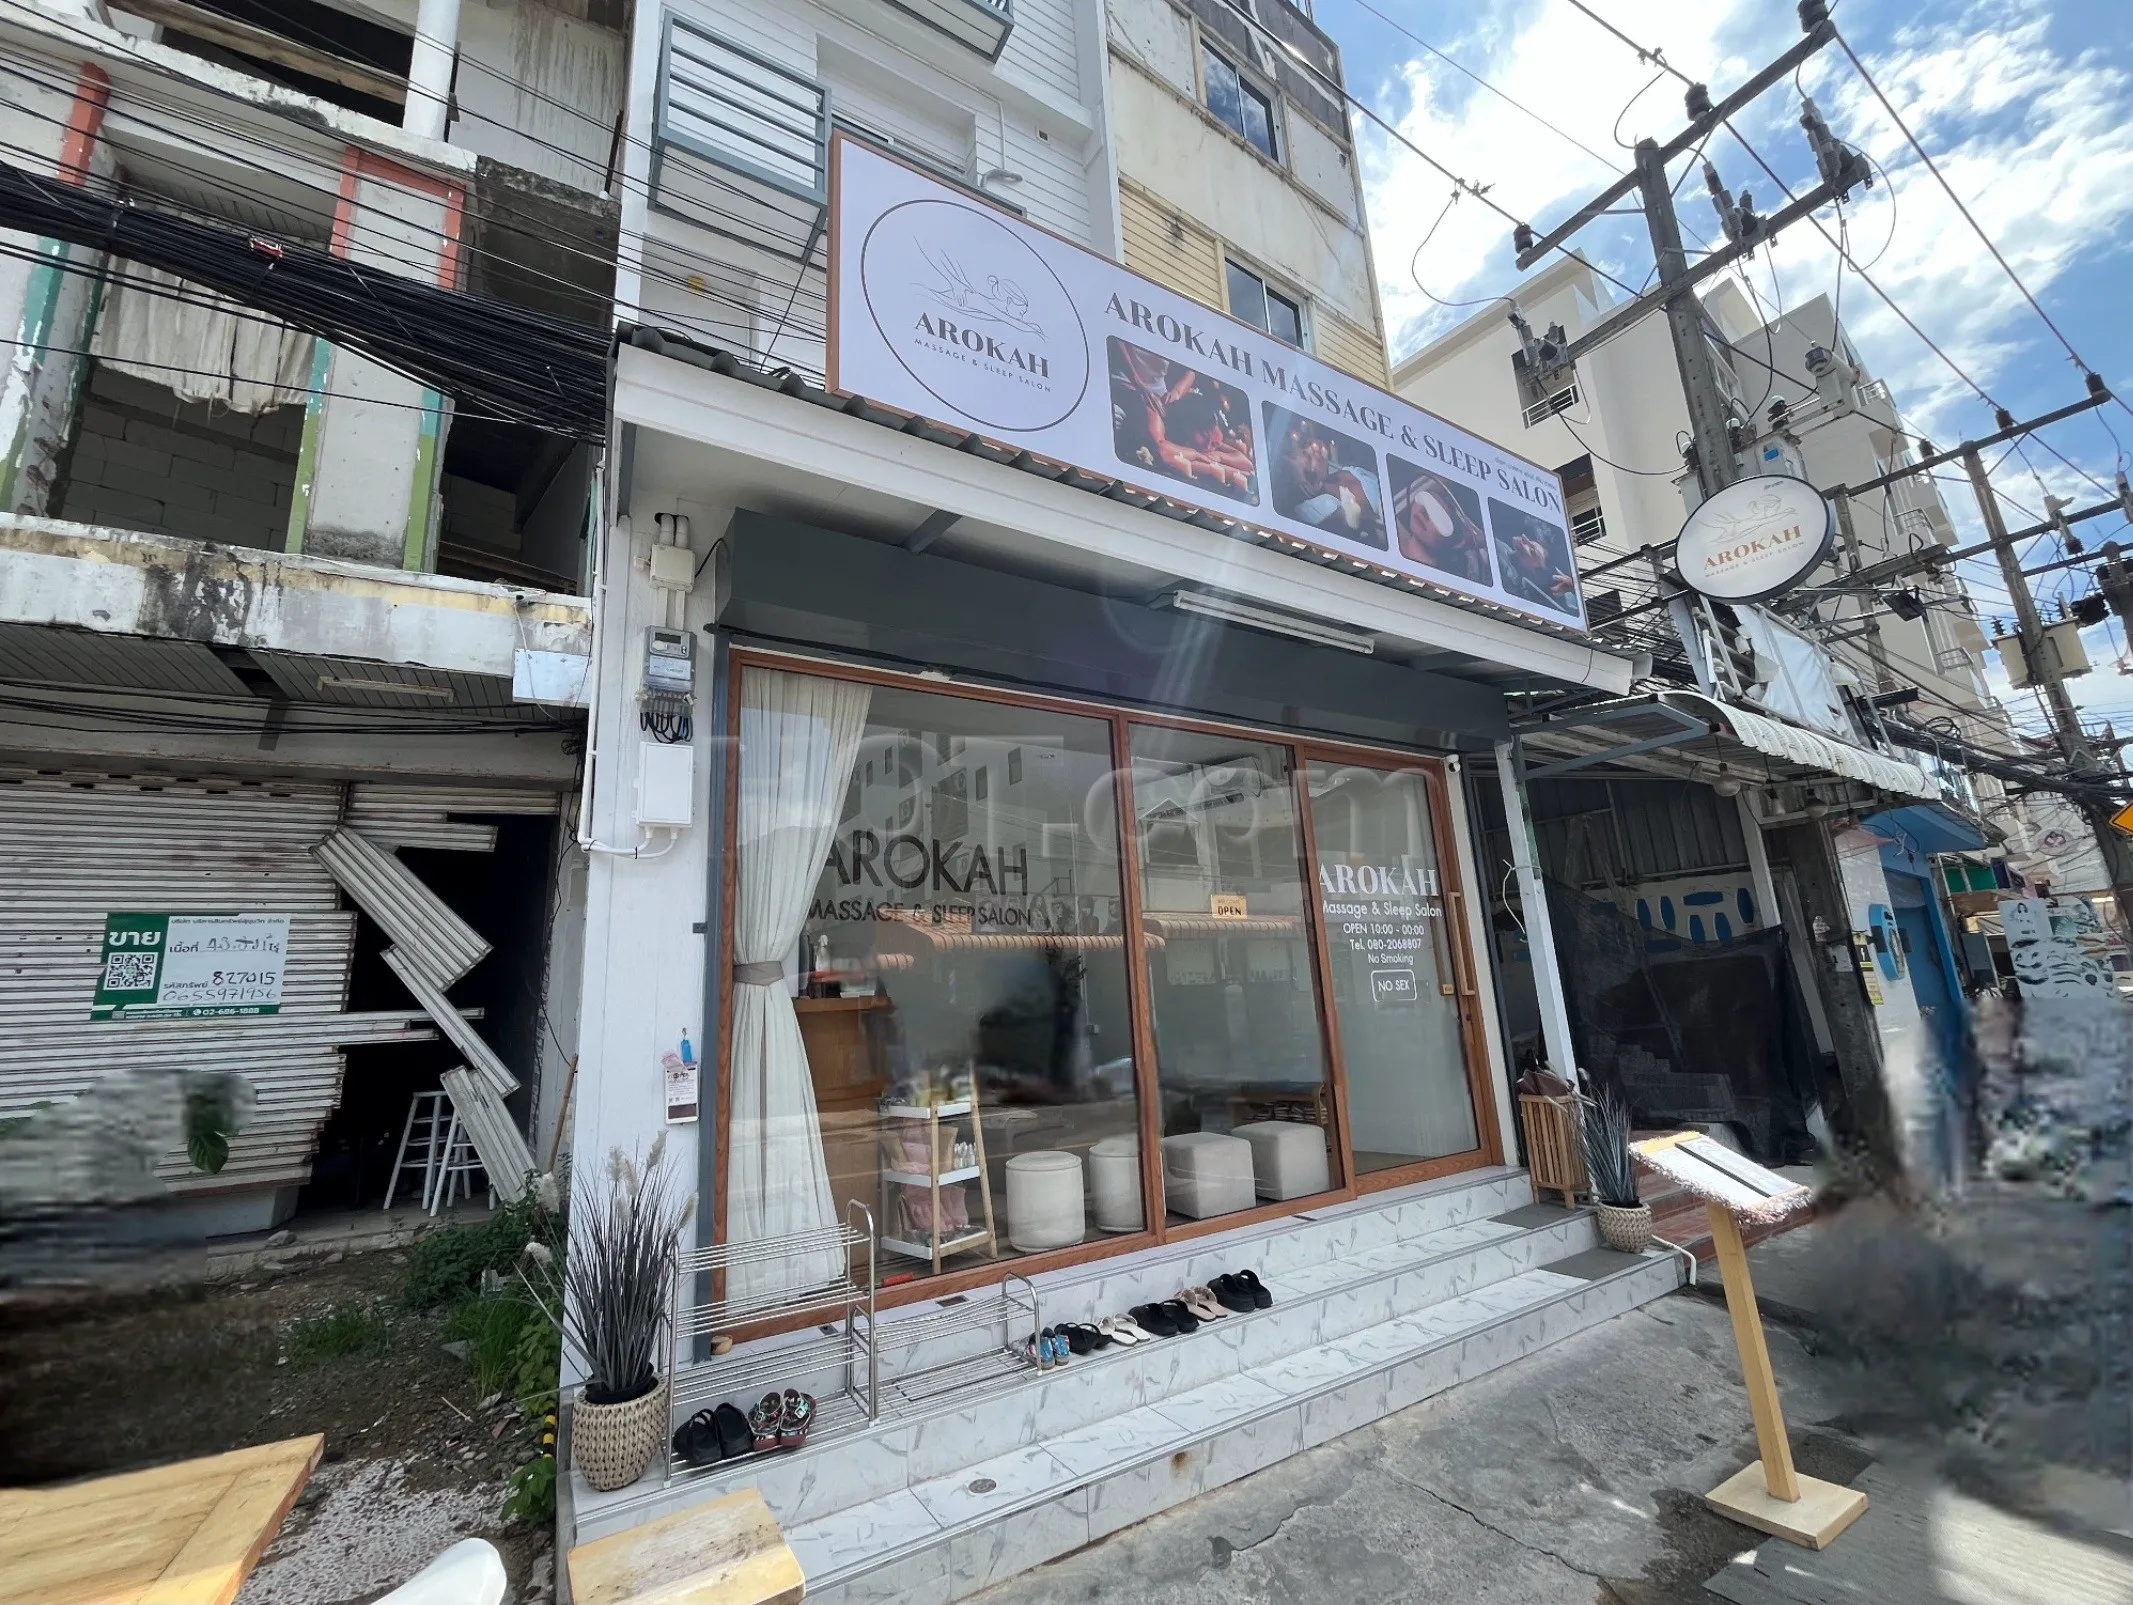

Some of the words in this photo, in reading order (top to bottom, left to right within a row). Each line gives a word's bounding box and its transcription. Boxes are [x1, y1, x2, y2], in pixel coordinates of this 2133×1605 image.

[914, 312, 1050, 378] AROKAH
[914, 338, 967, 362] MASSAGE
[984, 363, 1013, 379] SLEEP
[1019, 376, 1051, 392] SALON
[1105, 292, 1253, 377] AROKAH
[1261, 359, 1394, 439] MASSAGE
[1400, 424, 1418, 450] &
[1423, 434, 1492, 481] SLEEP
[1496, 468, 1561, 514] SALON
[1704, 525, 1801, 570] AROKAH
[1319, 862, 1440, 897] AROKAH
[978, 905, 1032, 926] SALON
[1217, 905, 1242, 916] OPEN
[1371, 902, 1381, 915] &
[1383, 901, 1412, 920] Sleep
[1414, 902, 1442, 917] Salon
[108, 931, 161, 946] ขาย
[1343, 923, 1367, 934] OPEN
[1367, 953, 1379, 963] No
[1381, 953, 1414, 966] Smoking
[1378, 981, 1393, 992] NO
[1395, 980, 1411, 991] SEX
